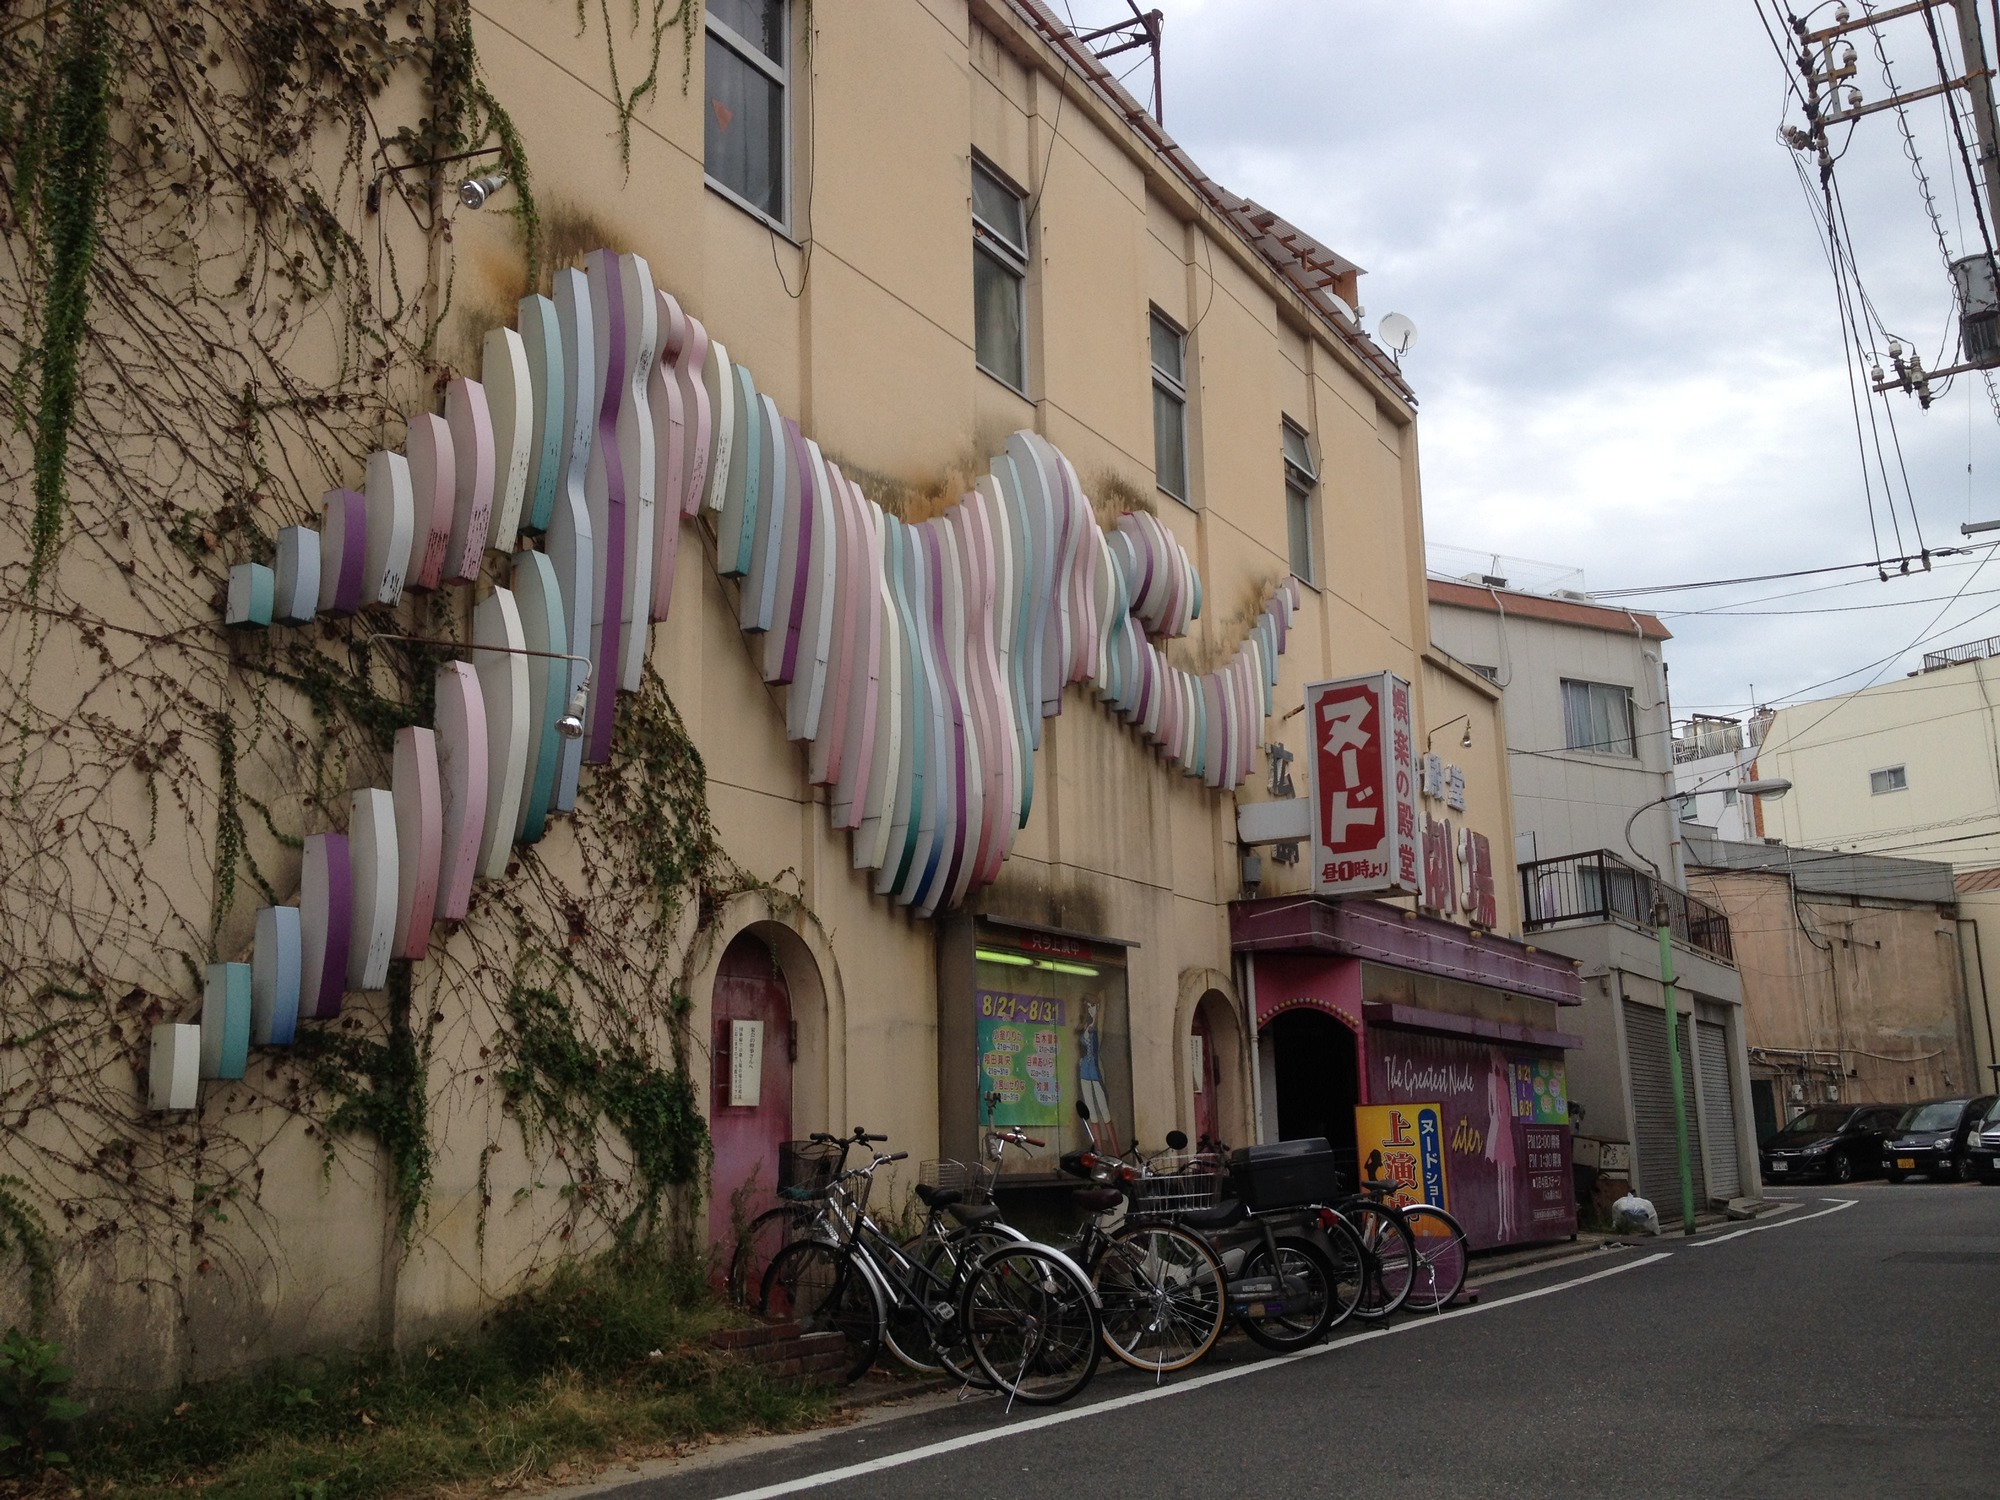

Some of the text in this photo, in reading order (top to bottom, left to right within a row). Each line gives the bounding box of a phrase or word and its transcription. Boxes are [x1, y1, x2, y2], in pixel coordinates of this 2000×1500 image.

[1322, 695, 1378, 844] ヌード
[1391, 685, 1416, 884] 娯楽の殿堂
[1384, 1054, 1403, 1091] The
[1404, 1058, 1448, 1098] Greatest
[1449, 1062, 1474, 1097] Nude
[1420, 1119, 1439, 1206] ヌードショー
